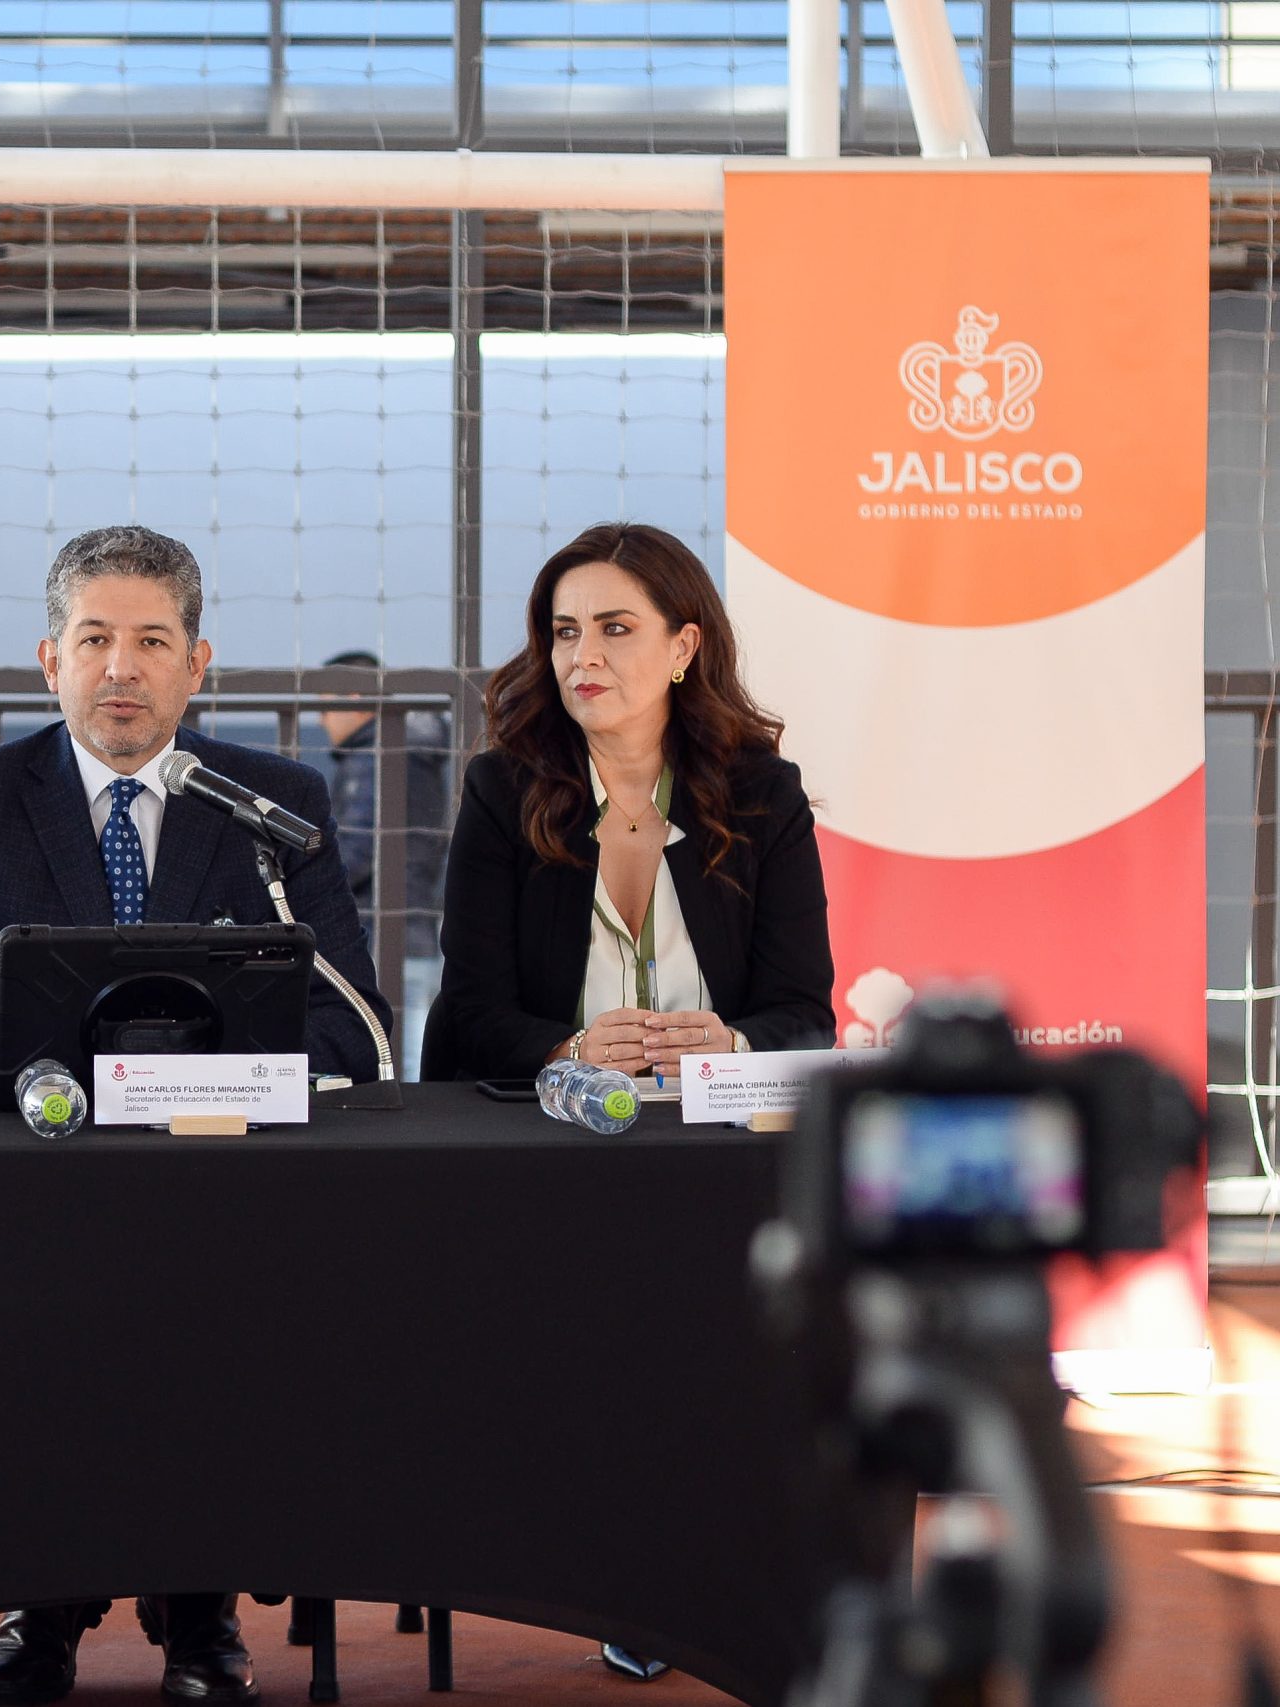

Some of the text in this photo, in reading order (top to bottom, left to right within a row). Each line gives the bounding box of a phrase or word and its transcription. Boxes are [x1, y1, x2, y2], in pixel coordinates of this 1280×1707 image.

[857, 452, 1083, 493] JALISCO
[858, 504, 1083, 519] GOBIERNO DEL ESTADO
[1009, 1019, 1123, 1045] ucación
[708, 1082, 744, 1090] ADRIANA
[745, 1080, 778, 1089] CIBRIÁN
[124, 1095, 261, 1103] Secretario de Educación del Estado de
[708, 1092, 746, 1101] Encargada
[708, 1101, 756, 1110] Incorporación
